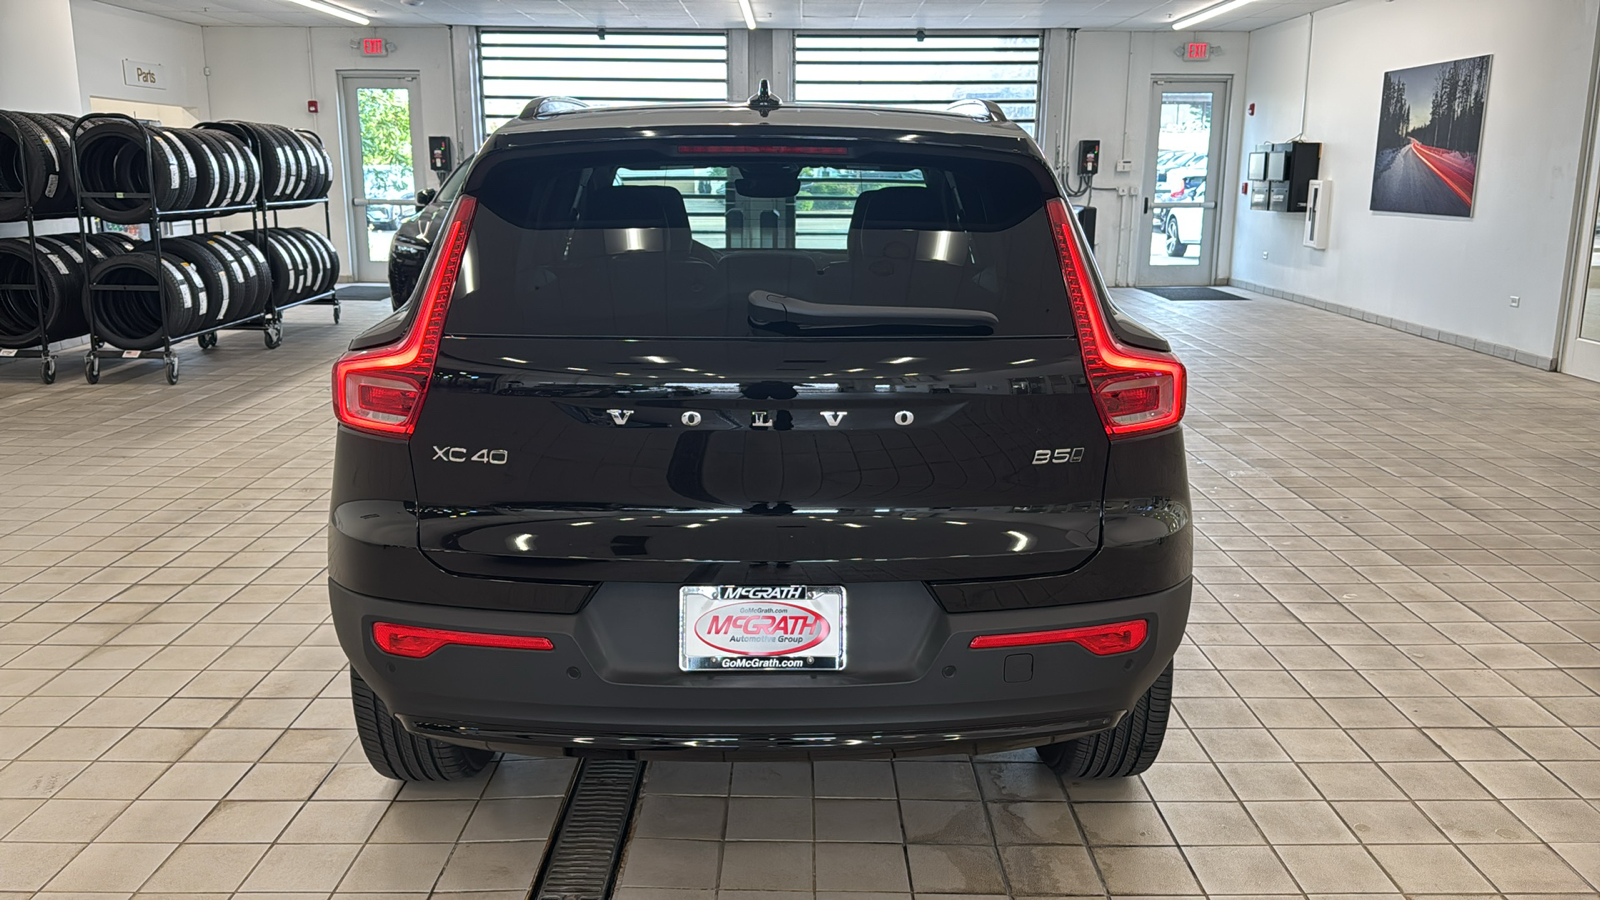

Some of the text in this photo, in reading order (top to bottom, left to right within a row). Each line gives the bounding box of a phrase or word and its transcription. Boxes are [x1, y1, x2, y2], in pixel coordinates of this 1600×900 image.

[363, 39, 382, 54] EXIT
[1188, 43, 1207, 58] EXIT
[136, 67, 156, 84] Parts
[729, 635, 804, 645] Automotive Group
[721, 658, 804, 668] GoMcGrath.com
